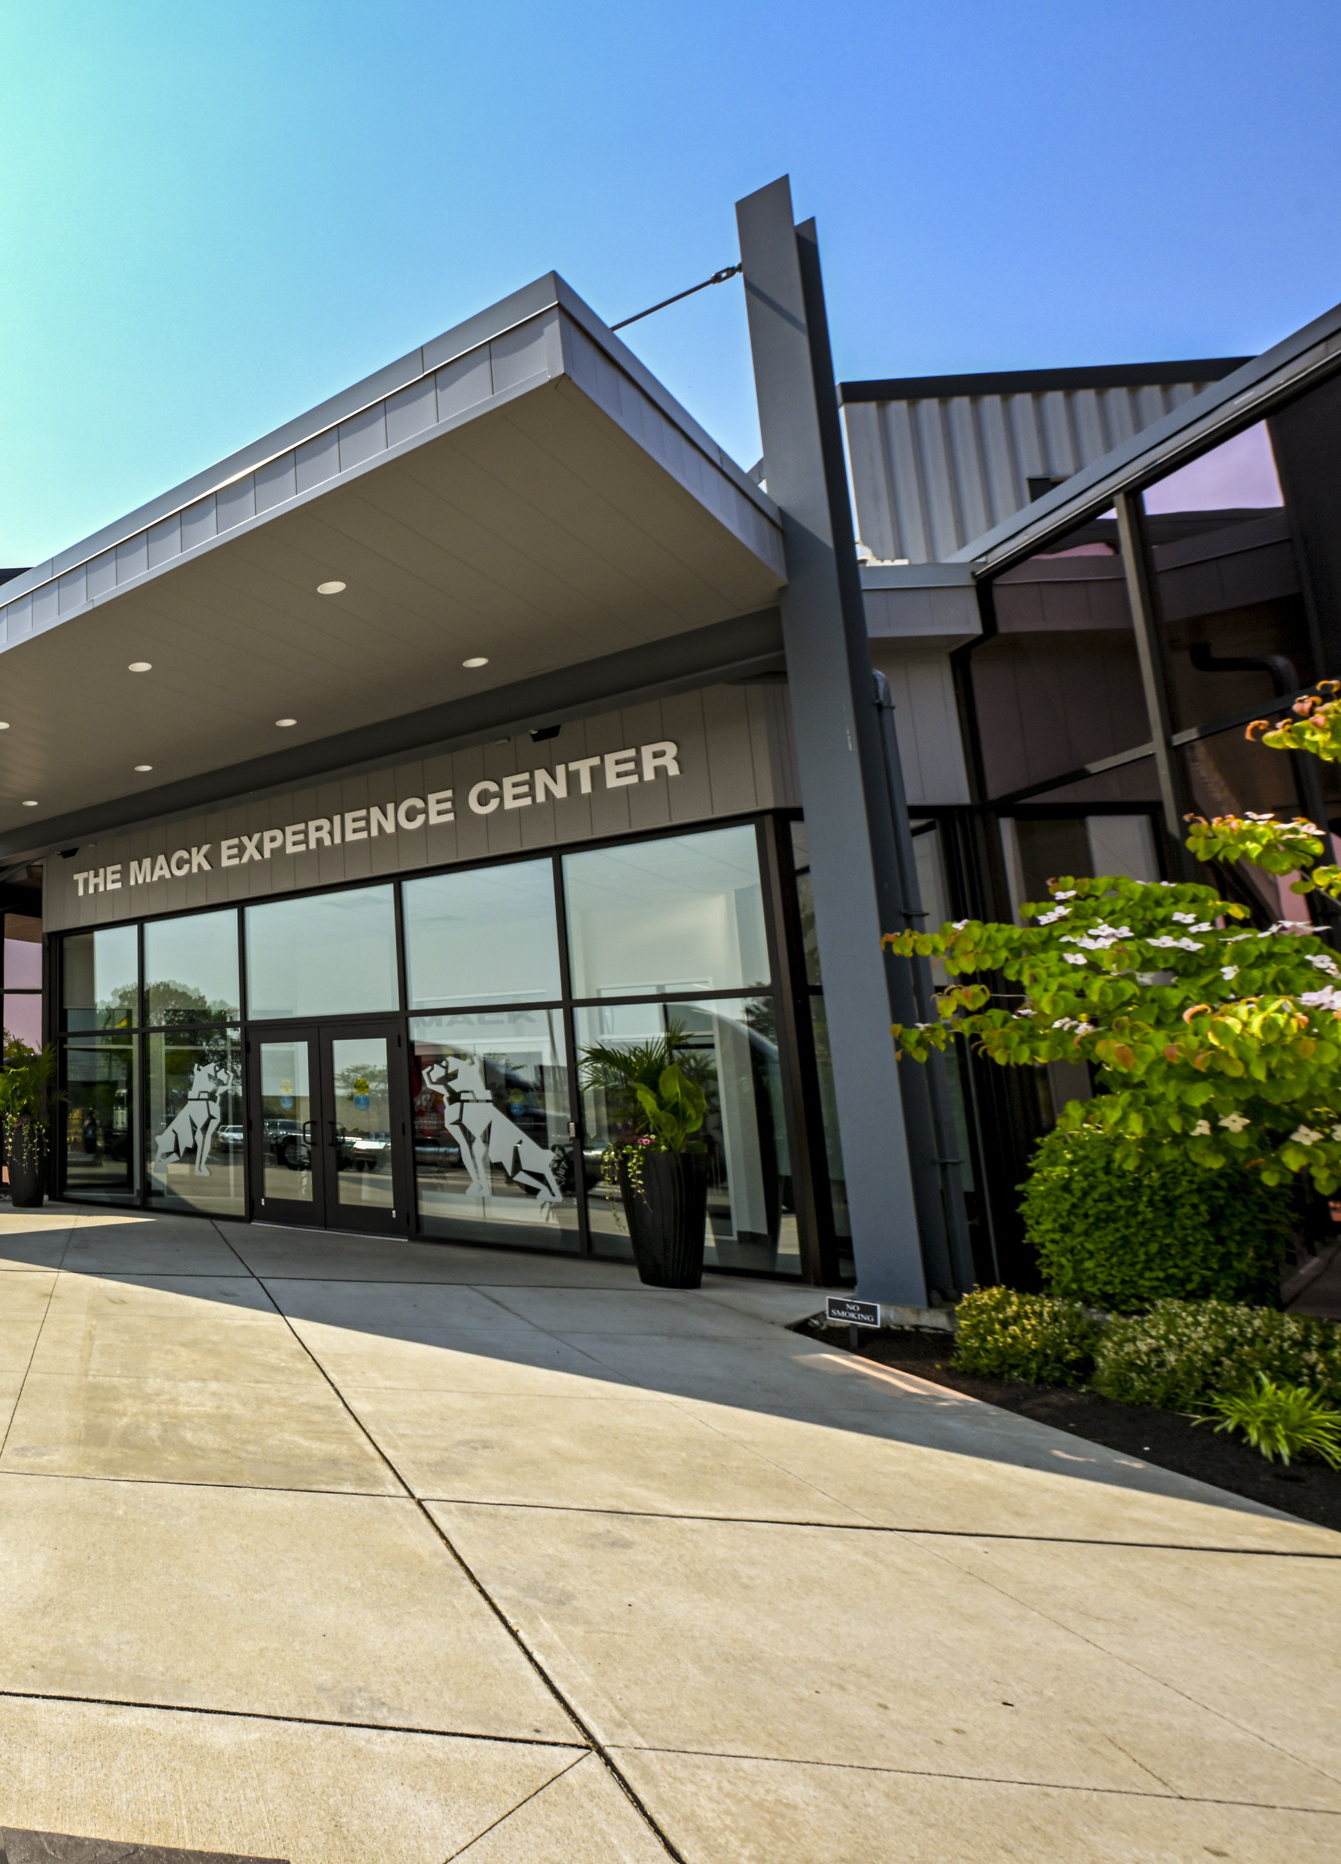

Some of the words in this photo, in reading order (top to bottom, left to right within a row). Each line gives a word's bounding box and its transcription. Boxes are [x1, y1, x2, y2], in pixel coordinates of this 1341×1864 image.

[73, 864, 122, 896] THE
[129, 844, 212, 886] MACK
[220, 789, 455, 868] EXPERIENCE
[468, 740, 681, 815] CENTER
[845, 1303, 860, 1312] NO
[830, 1309, 875, 1322] SMOKING
